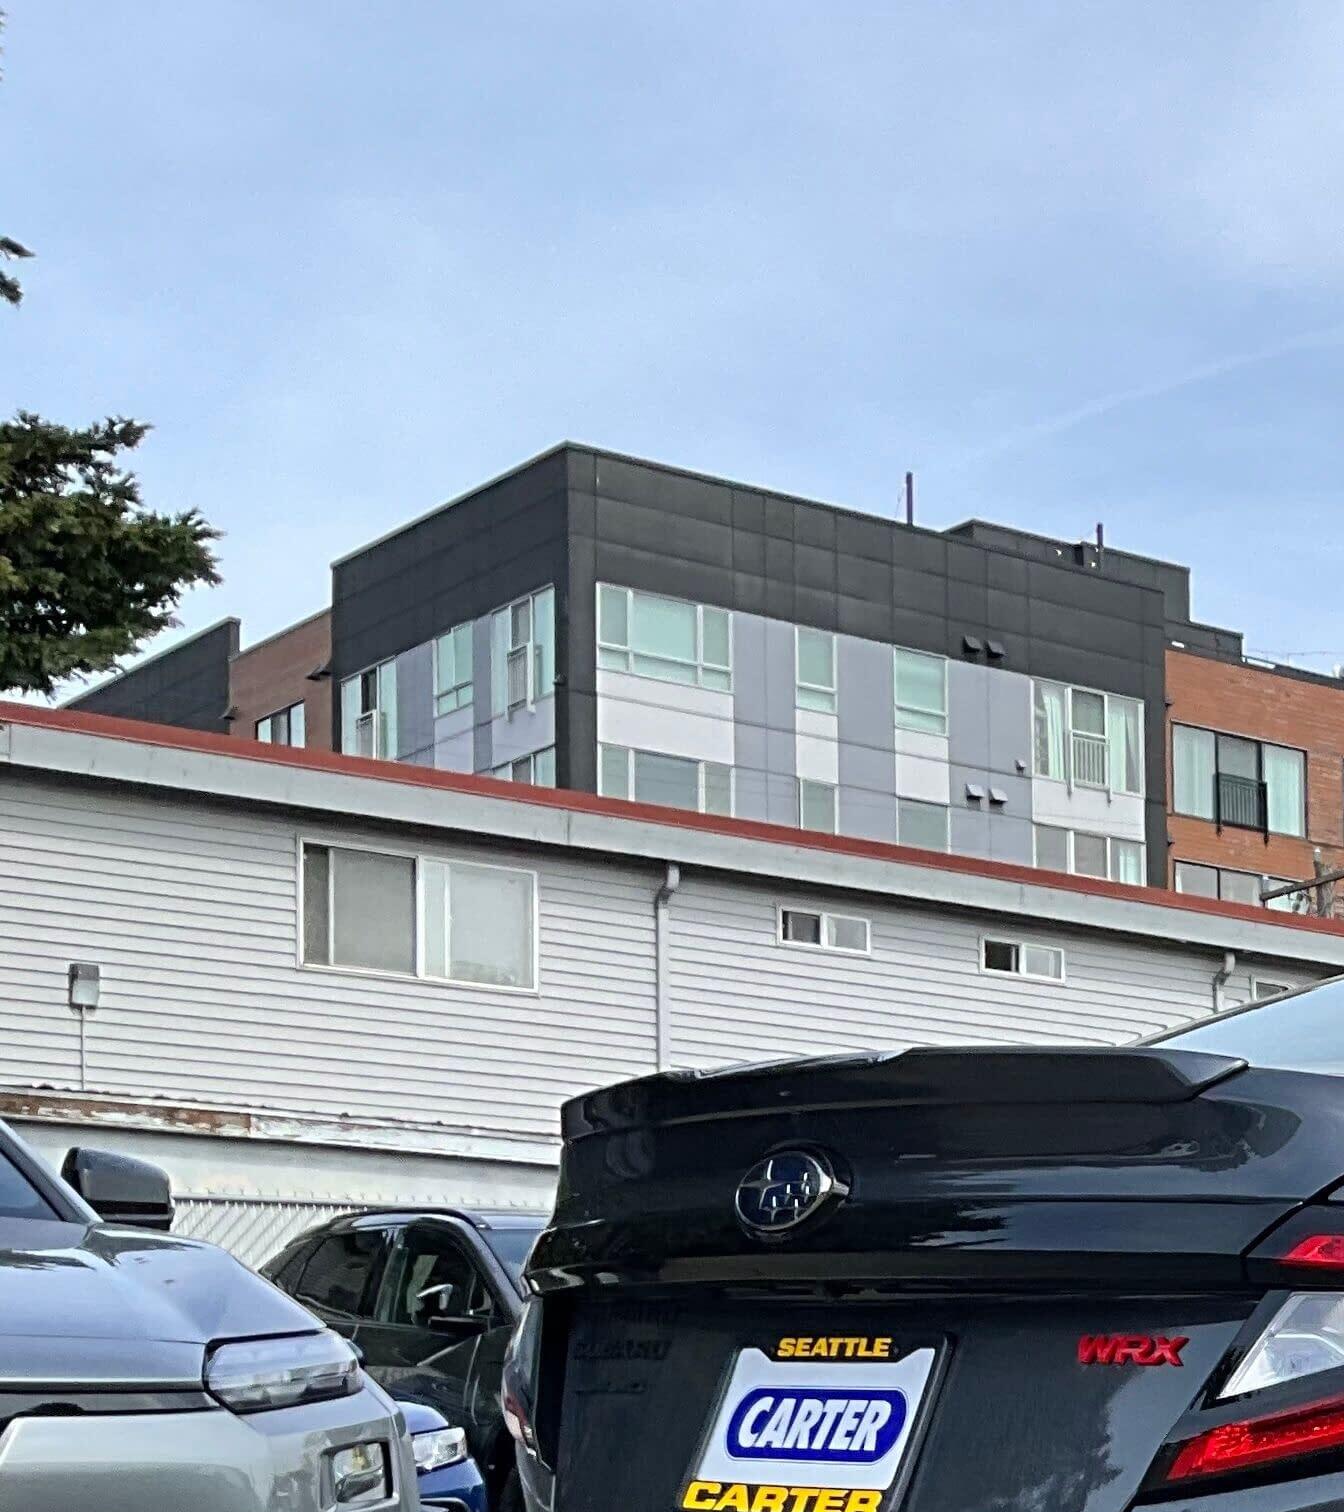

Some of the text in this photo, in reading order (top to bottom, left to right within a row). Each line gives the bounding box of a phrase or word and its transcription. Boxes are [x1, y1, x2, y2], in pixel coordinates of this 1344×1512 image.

[777, 1337, 891, 1357] SEATTLE
[1078, 1333, 1190, 1367] WRX
[738, 1396, 892, 1451] CARTER
